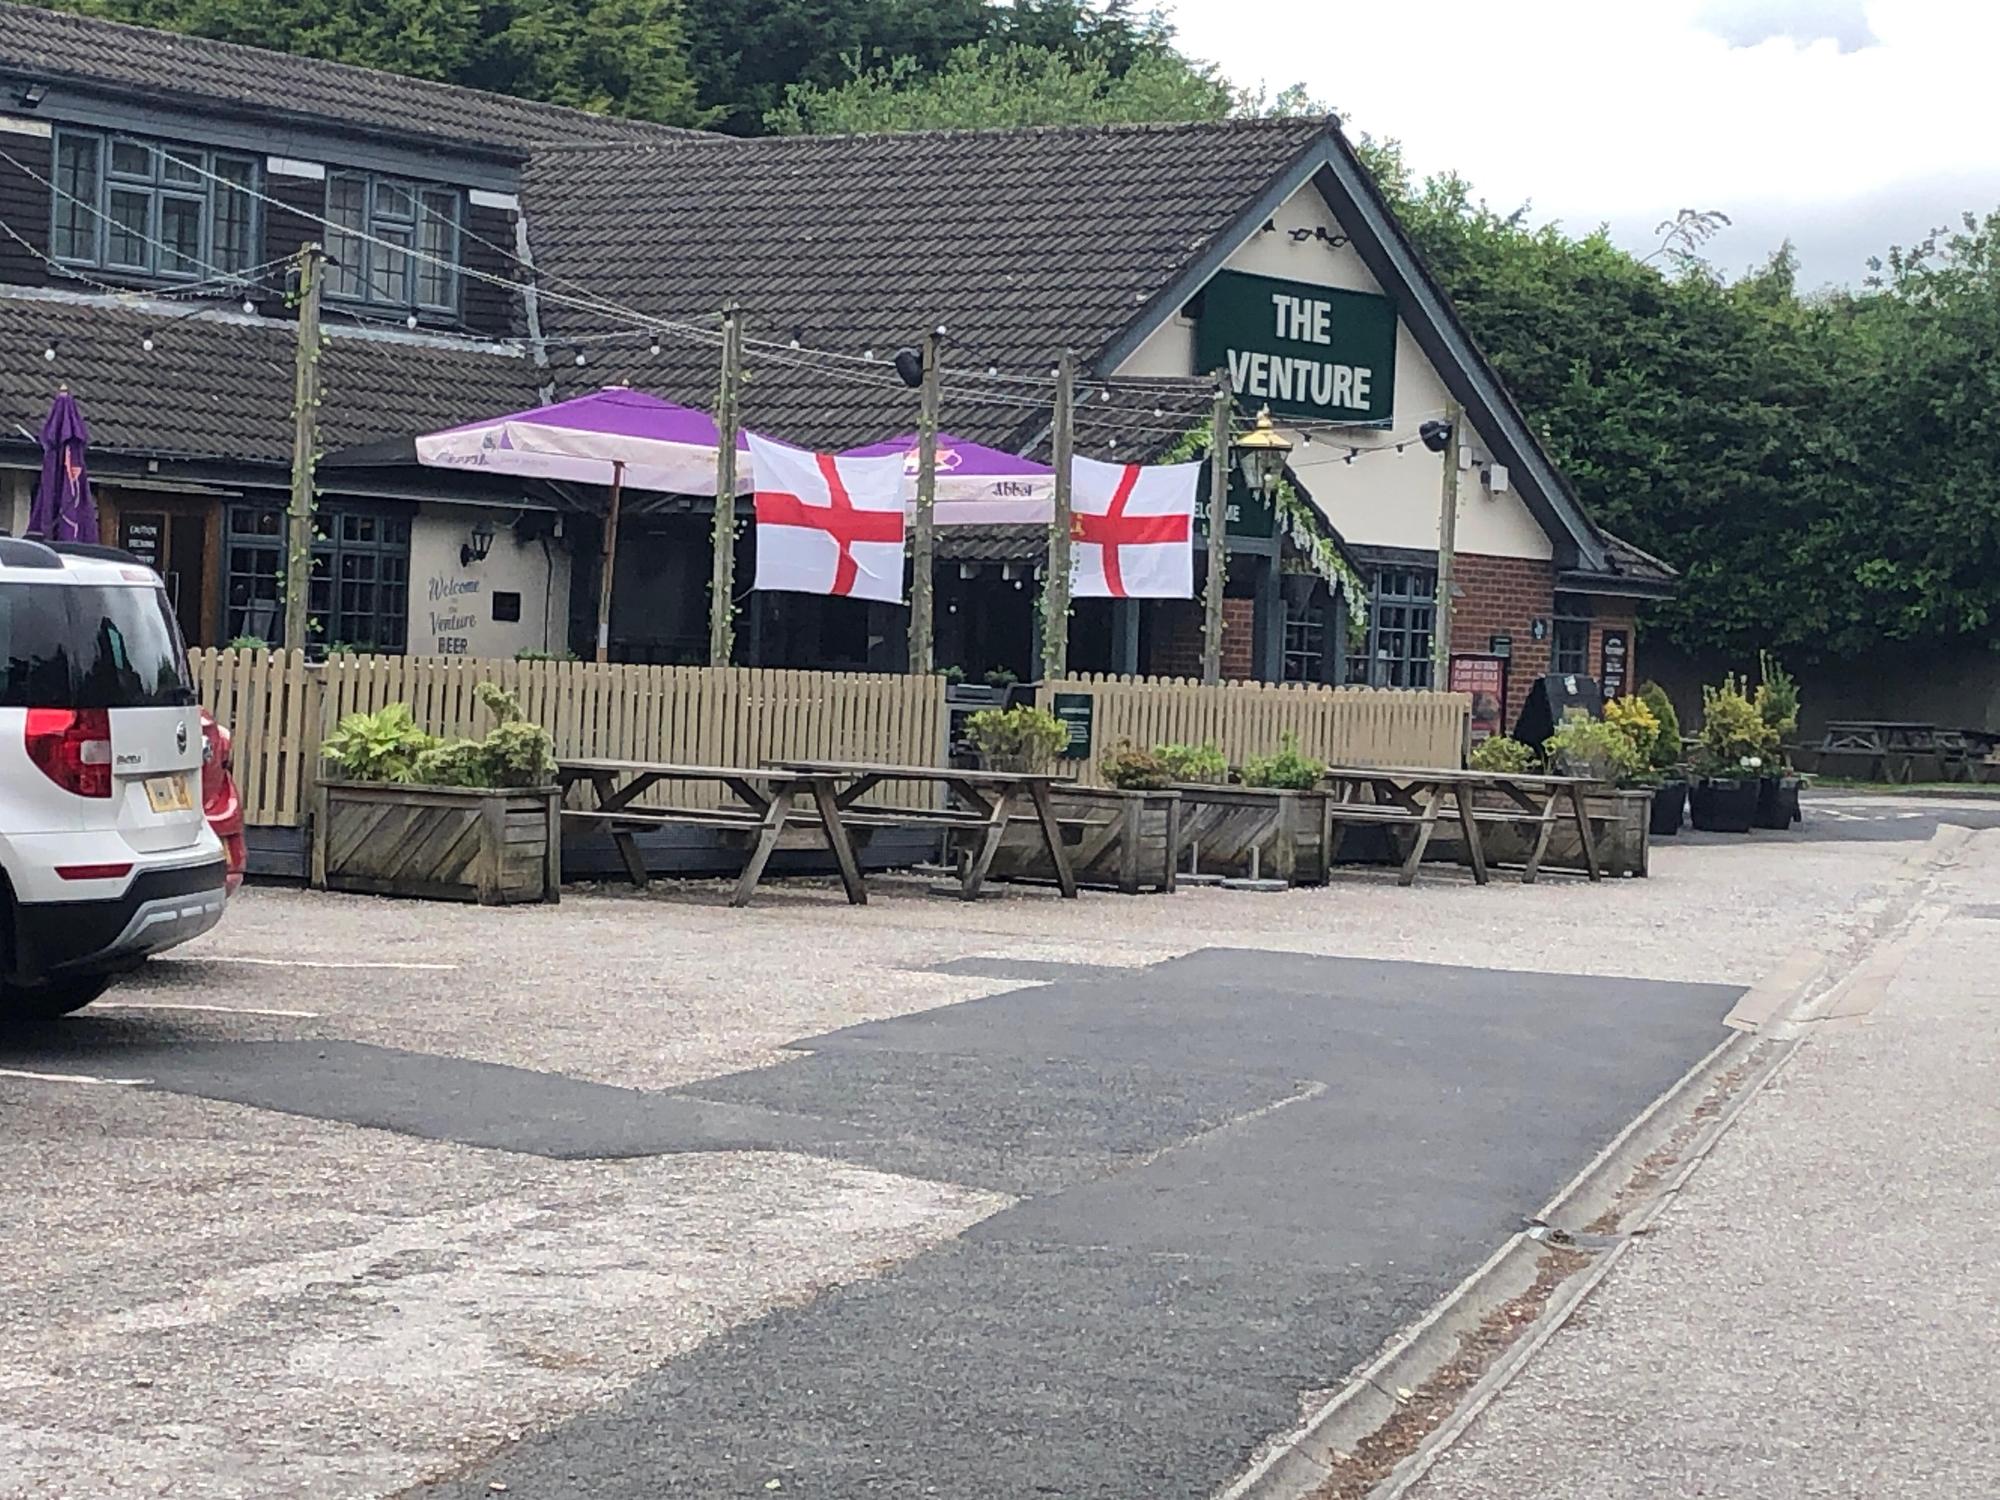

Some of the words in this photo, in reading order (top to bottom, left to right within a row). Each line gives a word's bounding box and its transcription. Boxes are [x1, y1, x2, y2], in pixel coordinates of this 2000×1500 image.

[1272, 294, 1332, 345] THE
[1227, 348, 1372, 411] VENTURE
[428, 576, 480, 600] Welcome
[429, 611, 477, 636] Venture
[438, 636, 468, 654] BEER
